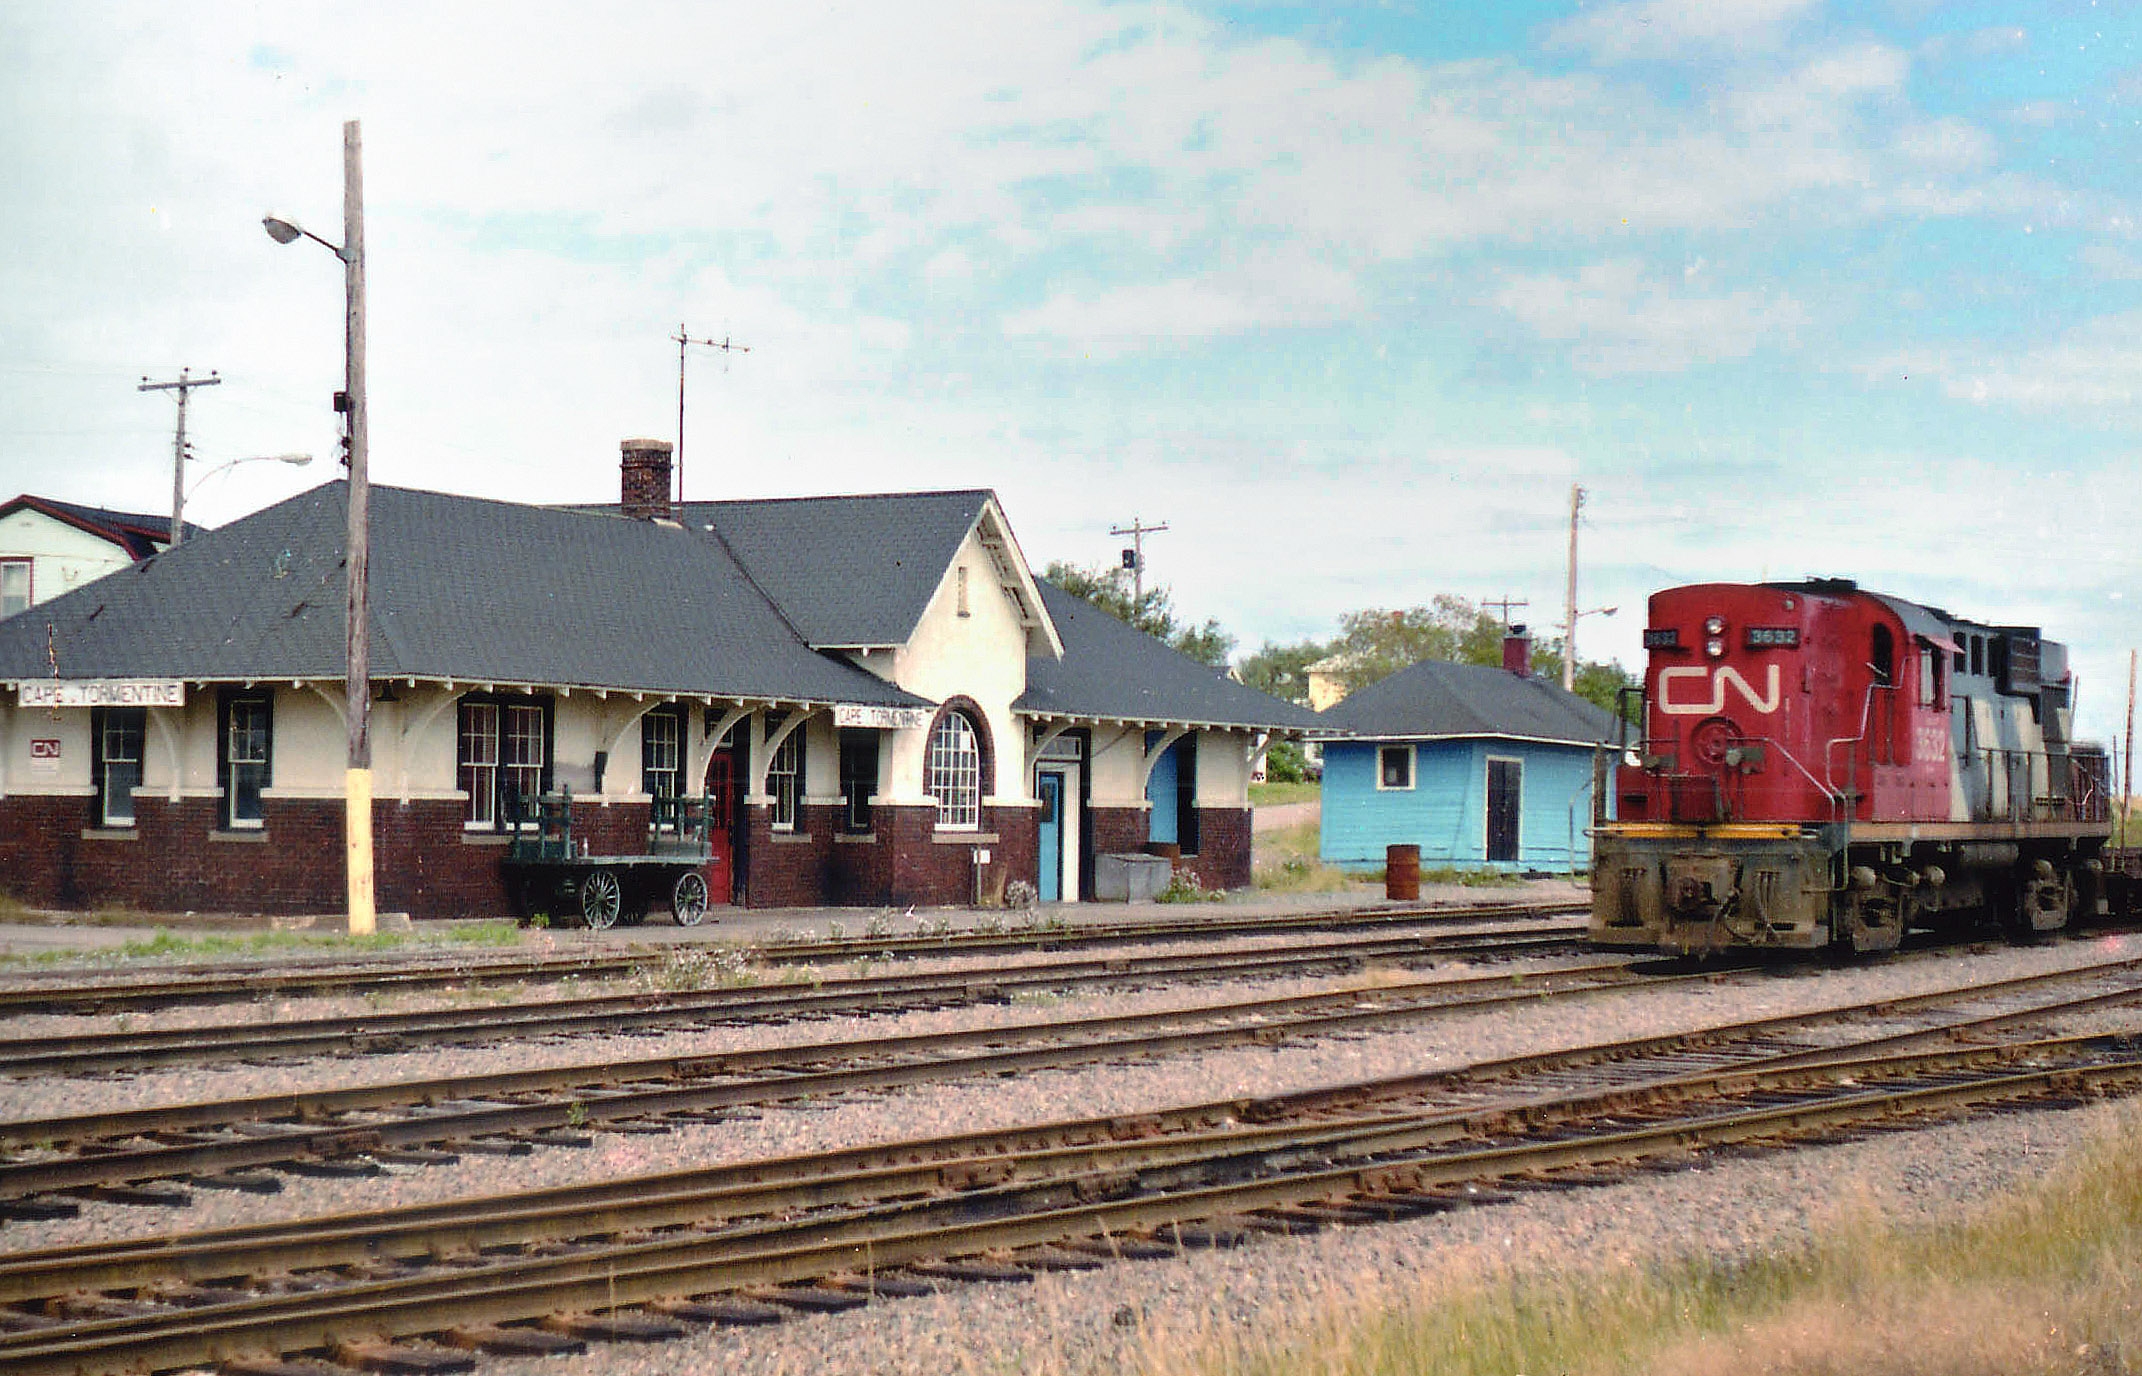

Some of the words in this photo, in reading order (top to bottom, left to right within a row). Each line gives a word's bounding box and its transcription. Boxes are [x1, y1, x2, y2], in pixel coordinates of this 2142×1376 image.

[1752, 629, 1796, 644] 3632
[23, 685, 63, 703] CAPE
[79, 684, 179, 704] TORMENTINE
[1658, 664, 1780, 715] CN
[838, 707, 862, 725] CAPE
[32, 742, 59, 756] CN
